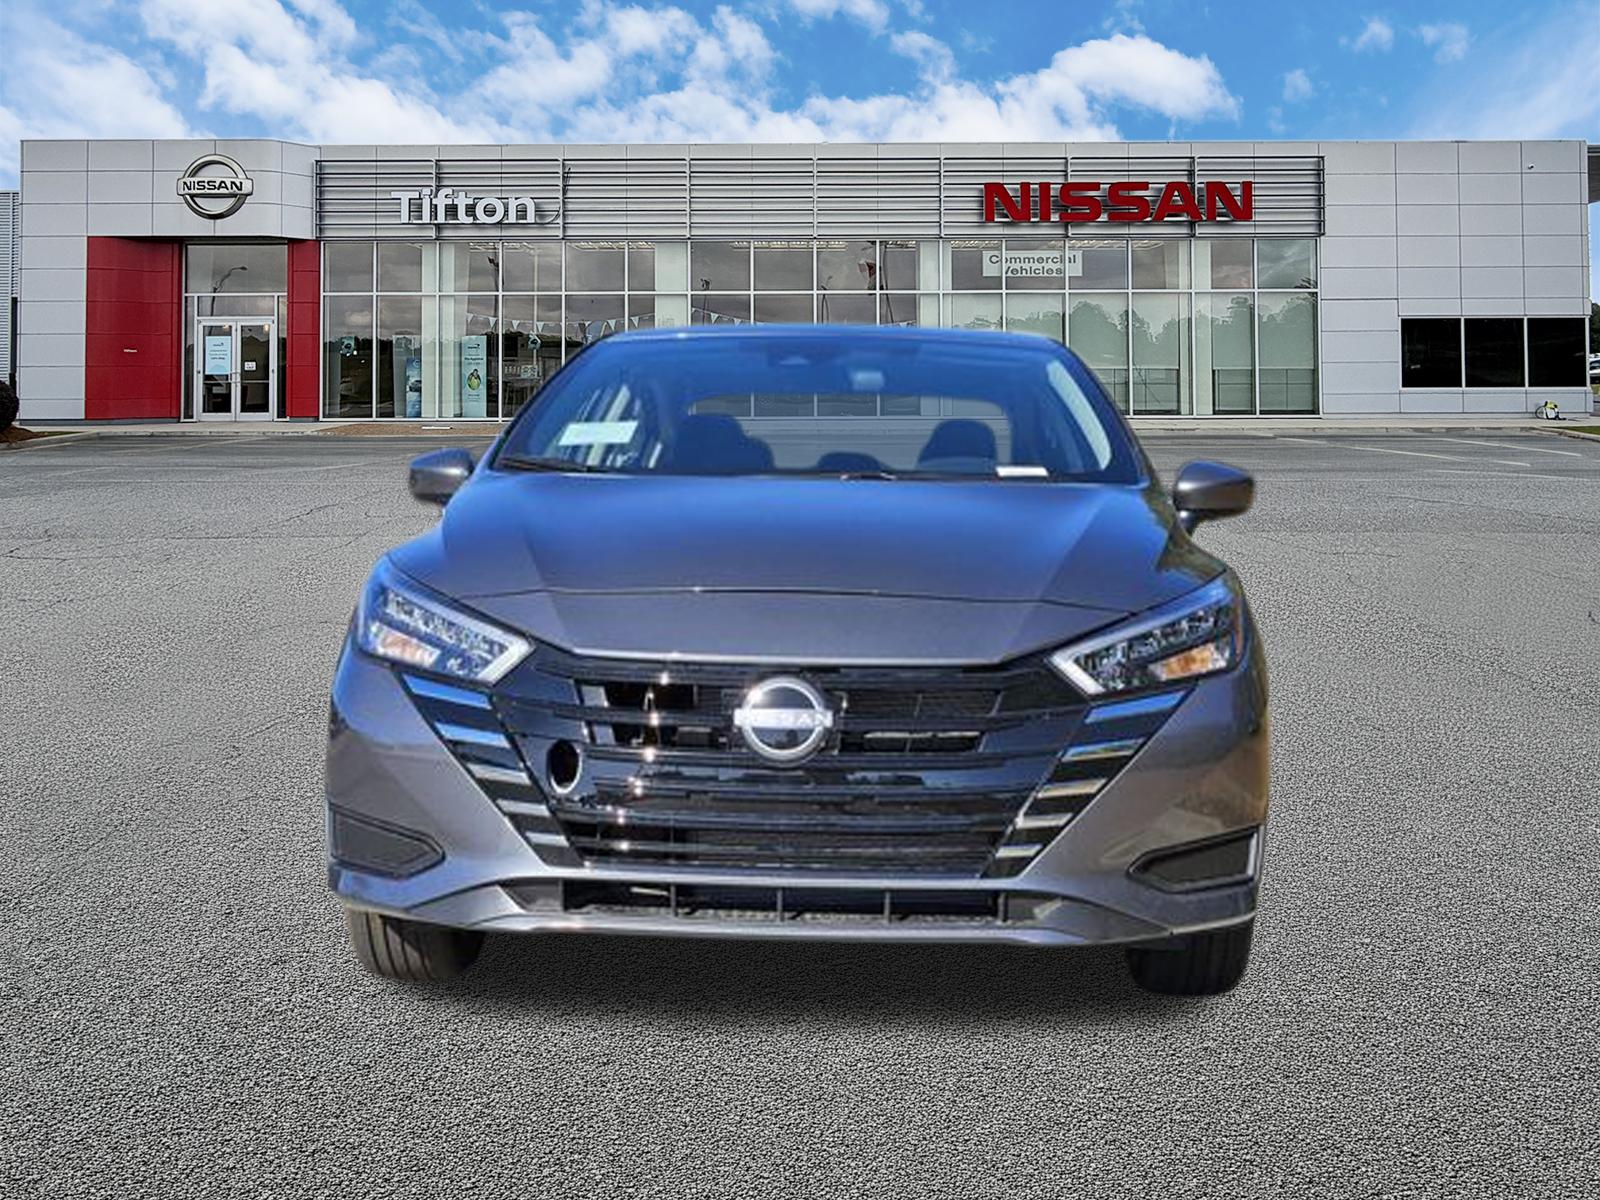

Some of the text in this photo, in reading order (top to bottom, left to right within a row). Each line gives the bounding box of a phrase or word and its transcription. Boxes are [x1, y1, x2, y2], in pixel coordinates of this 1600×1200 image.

[183, 180, 243, 192] NISSAN
[983, 180, 1254, 223] NISSAN
[391, 188, 536, 224] Tifton
